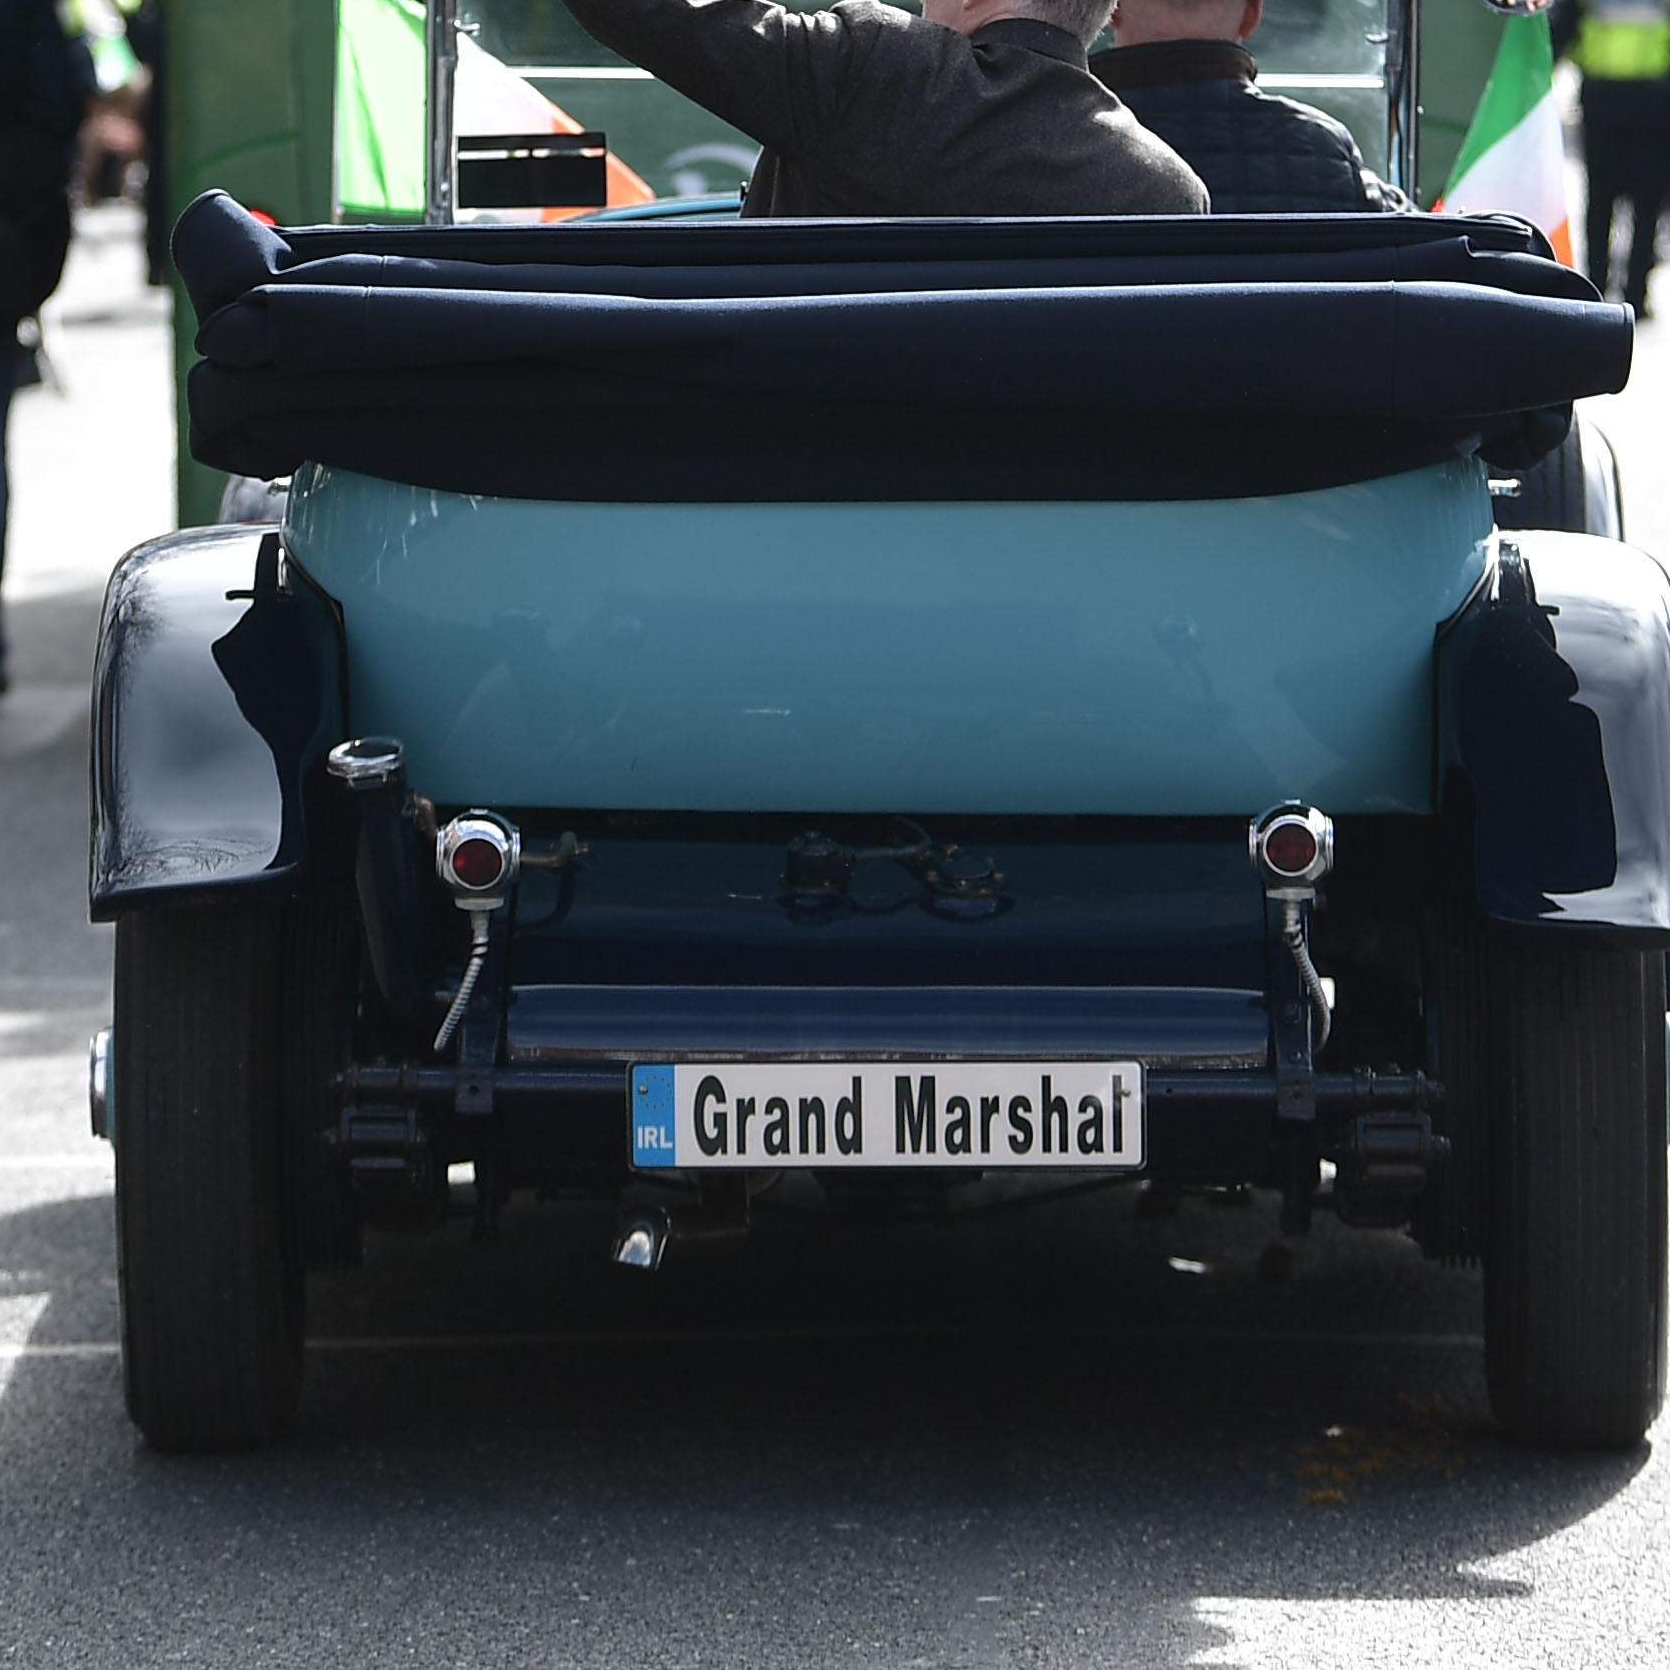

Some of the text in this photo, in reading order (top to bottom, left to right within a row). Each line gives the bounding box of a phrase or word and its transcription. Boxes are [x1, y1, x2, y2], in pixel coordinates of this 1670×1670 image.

[637, 1126, 673, 1150] IRL
[693, 1074, 1124, 1157] Grand Marshal
